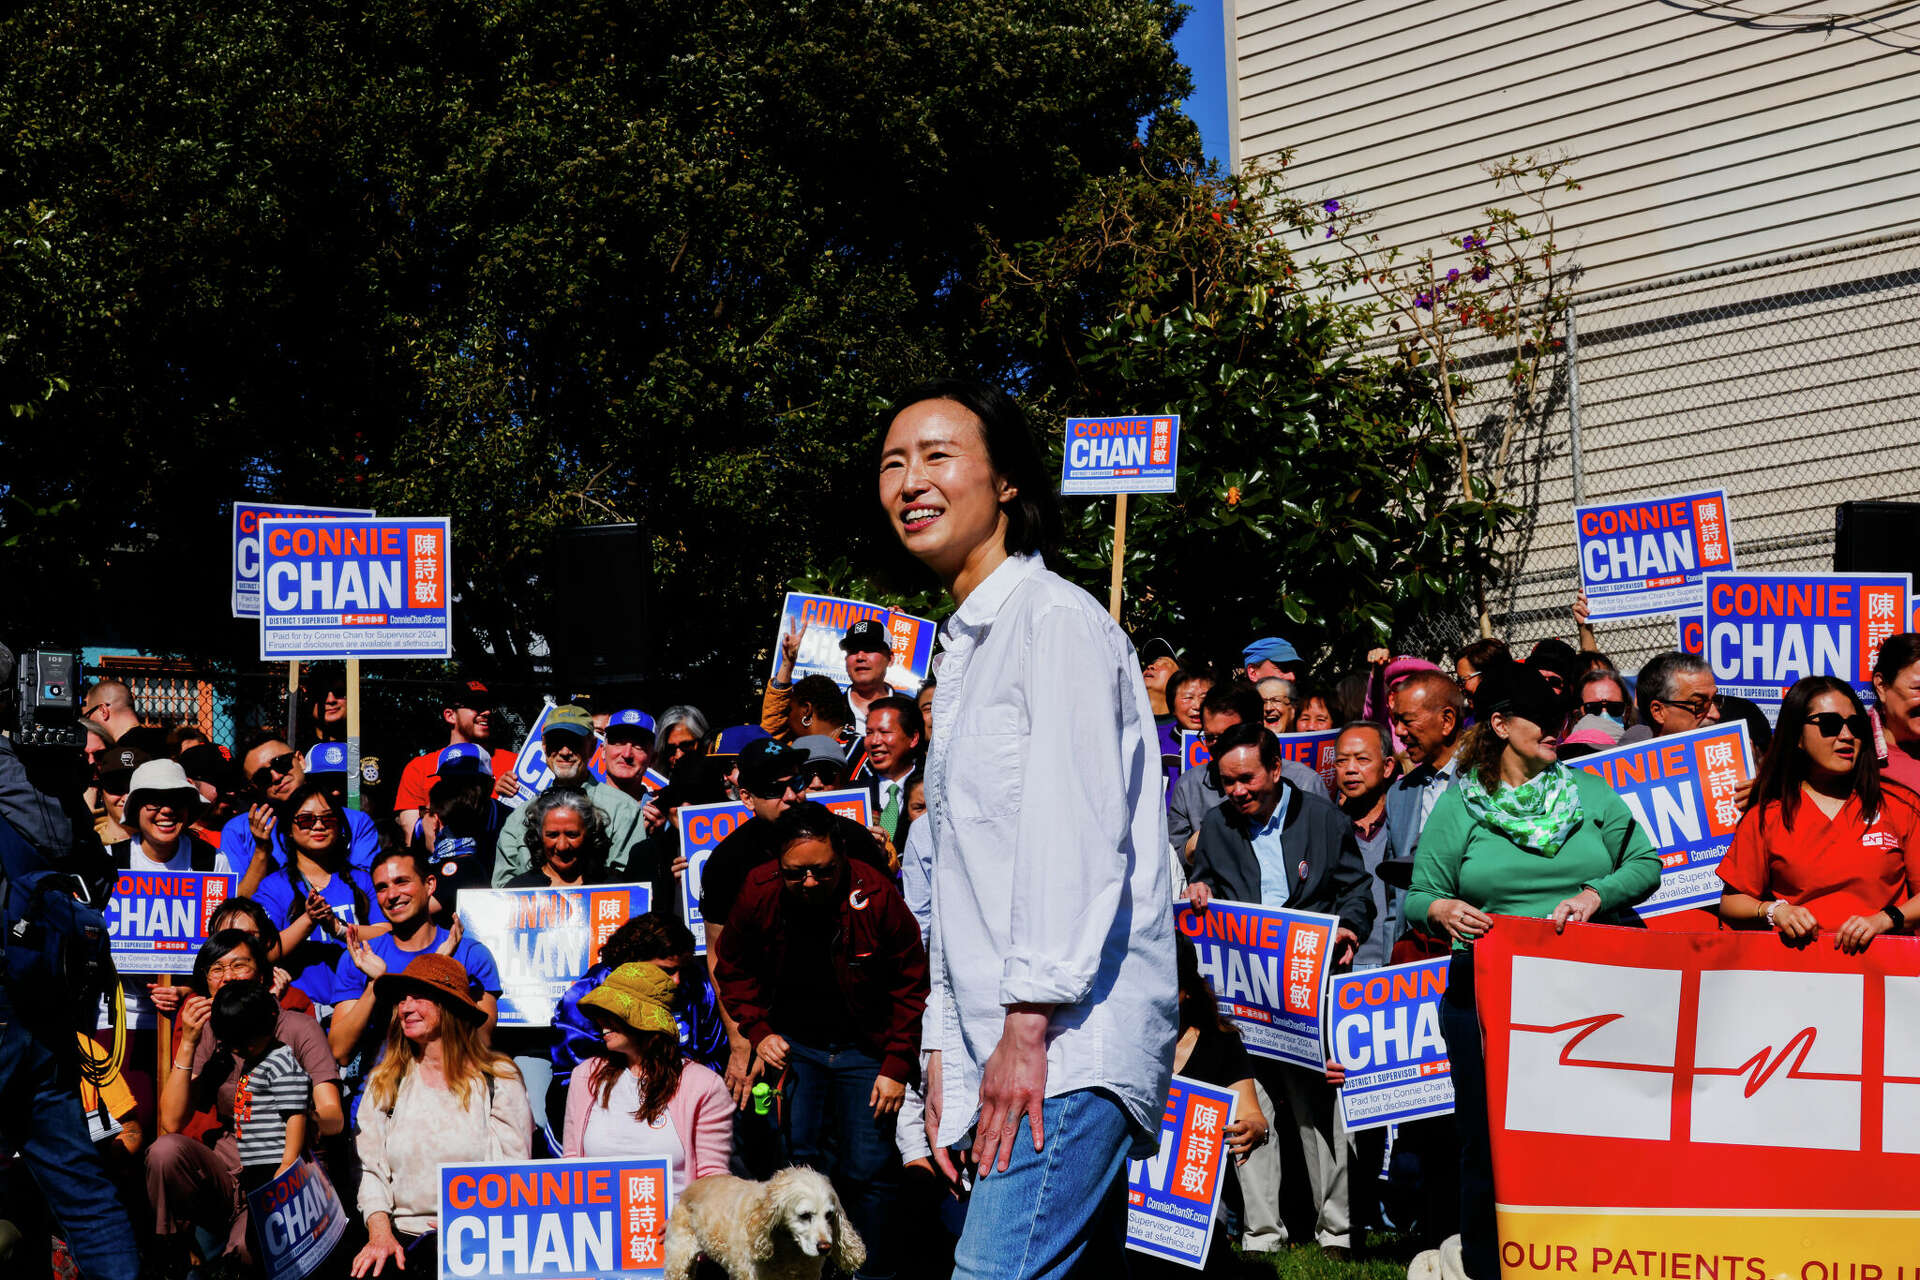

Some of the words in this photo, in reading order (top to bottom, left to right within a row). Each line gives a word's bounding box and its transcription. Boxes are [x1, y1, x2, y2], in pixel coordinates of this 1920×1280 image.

[1074, 421, 1148, 437] CONNIE
[1070, 437, 1147, 468] CHAN
[1581, 502, 1688, 537] CONNIE
[1698, 502, 1724, 561] 陳詩敏
[269, 528, 401, 556] CONNIE
[1583, 529, 1695, 582] CHAN
[266, 560, 402, 611] CHAN
[414, 534, 438, 603] 陳詩敏
[1588, 585, 1610, 593] DISTRICT
[1614, 582, 1644, 592] SUPERVISOR
[302, 616, 338, 624] SUPERVISOR
[801, 599, 884, 630] CONNIE
[1711, 583, 1852, 617] CONNIE
[314, 632, 340, 640] Connie
[342, 631, 363, 640] Chan
[377, 631, 416, 641] Supervisor
[1709, 621, 1852, 682] CHAN
[1867, 592, 1896, 672] 陳詩
[1716, 688, 1738, 697] STRICT
[1744, 688, 1779, 698] SUPERVISOR
[1584, 744, 1689, 788] NNIE
[1704, 741, 1742, 827] 陳詩敏
[1621, 780, 1702, 849] AN
[112, 876, 196, 896] ONNIE
[1660, 884, 1700, 900] available
[1703, 882, 1711, 890] at
[1664, 877, 1676, 887] for
[1678, 870, 1714, 884] Supervi
[205, 880, 225, 932] 陳詩
[512, 893, 583, 929] NNIE
[1174, 908, 1283, 950] ONNIE
[1194, 943, 1281, 1010] HAN
[1290, 929, 1320, 1010] 陳詩敏
[1338, 966, 1449, 1010] CONN
[1336, 1001, 1446, 1071] CHA
[1344, 1077, 1372, 1089] DISTRICT
[1377, 1068, 1417, 1082] SUPERVISOR
[1351, 1096, 1368, 1106] Paid
[1370, 1094, 1380, 1103] for
[1382, 1092, 1392, 1102] by
[1393, 1086, 1421, 1098] Connie
[1424, 1082, 1446, 1092] Chan
[1349, 1106, 1382, 1118] Financial
[1384, 1098, 1426, 1111] disclosures
[1180, 1103, 1220, 1195] 陳詩敏
[264, 1165, 309, 1213] CONN
[449, 1170, 612, 1210] CONNIE
[265, 1176, 328, 1256] CHAN
[628, 1176, 658, 1263] 陳詩敏
[1128, 1212, 1172, 1233] Supervisor
[1146, 1196, 1208, 1224] ConnieChanSF.com
[446, 1210, 614, 1277] CHAN
[1145, 1231, 1153, 1239] at
[1155, 1233, 1200, 1254] sfethics.org
[1502, 1240, 1577, 1272] OUR
[1592, 1247, 1774, 1280] PATIENTS
[1801, 1260, 1883, 1280] OUR
